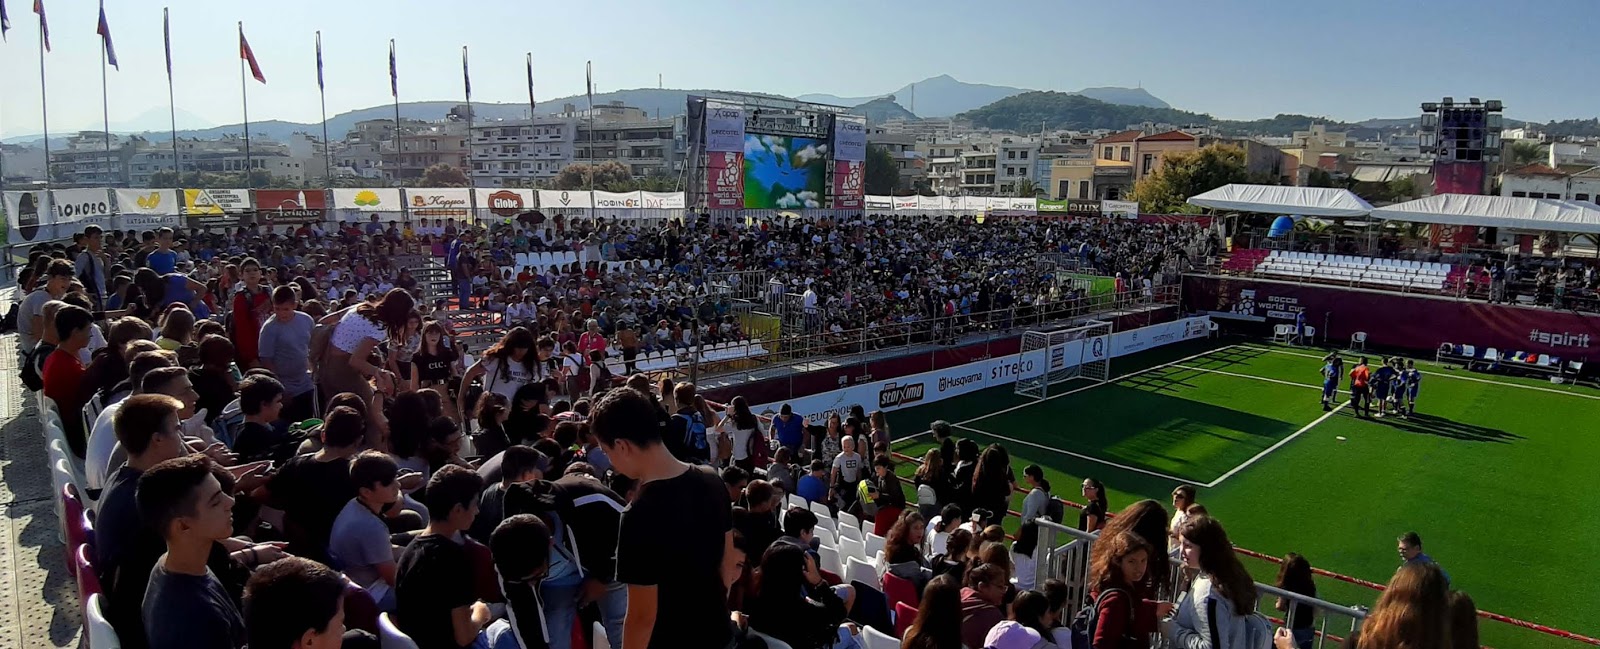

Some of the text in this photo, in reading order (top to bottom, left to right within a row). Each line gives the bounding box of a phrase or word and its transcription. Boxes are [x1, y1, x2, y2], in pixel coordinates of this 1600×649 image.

[493, 198, 518, 209] Globe
[1039, 203, 1065, 211] Europcar
[1078, 204, 1100, 212] LUX
[1258, 302, 1285, 311] world
[1529, 329, 1590, 348] #spirit
[946, 372, 983, 389] Husqvarna
